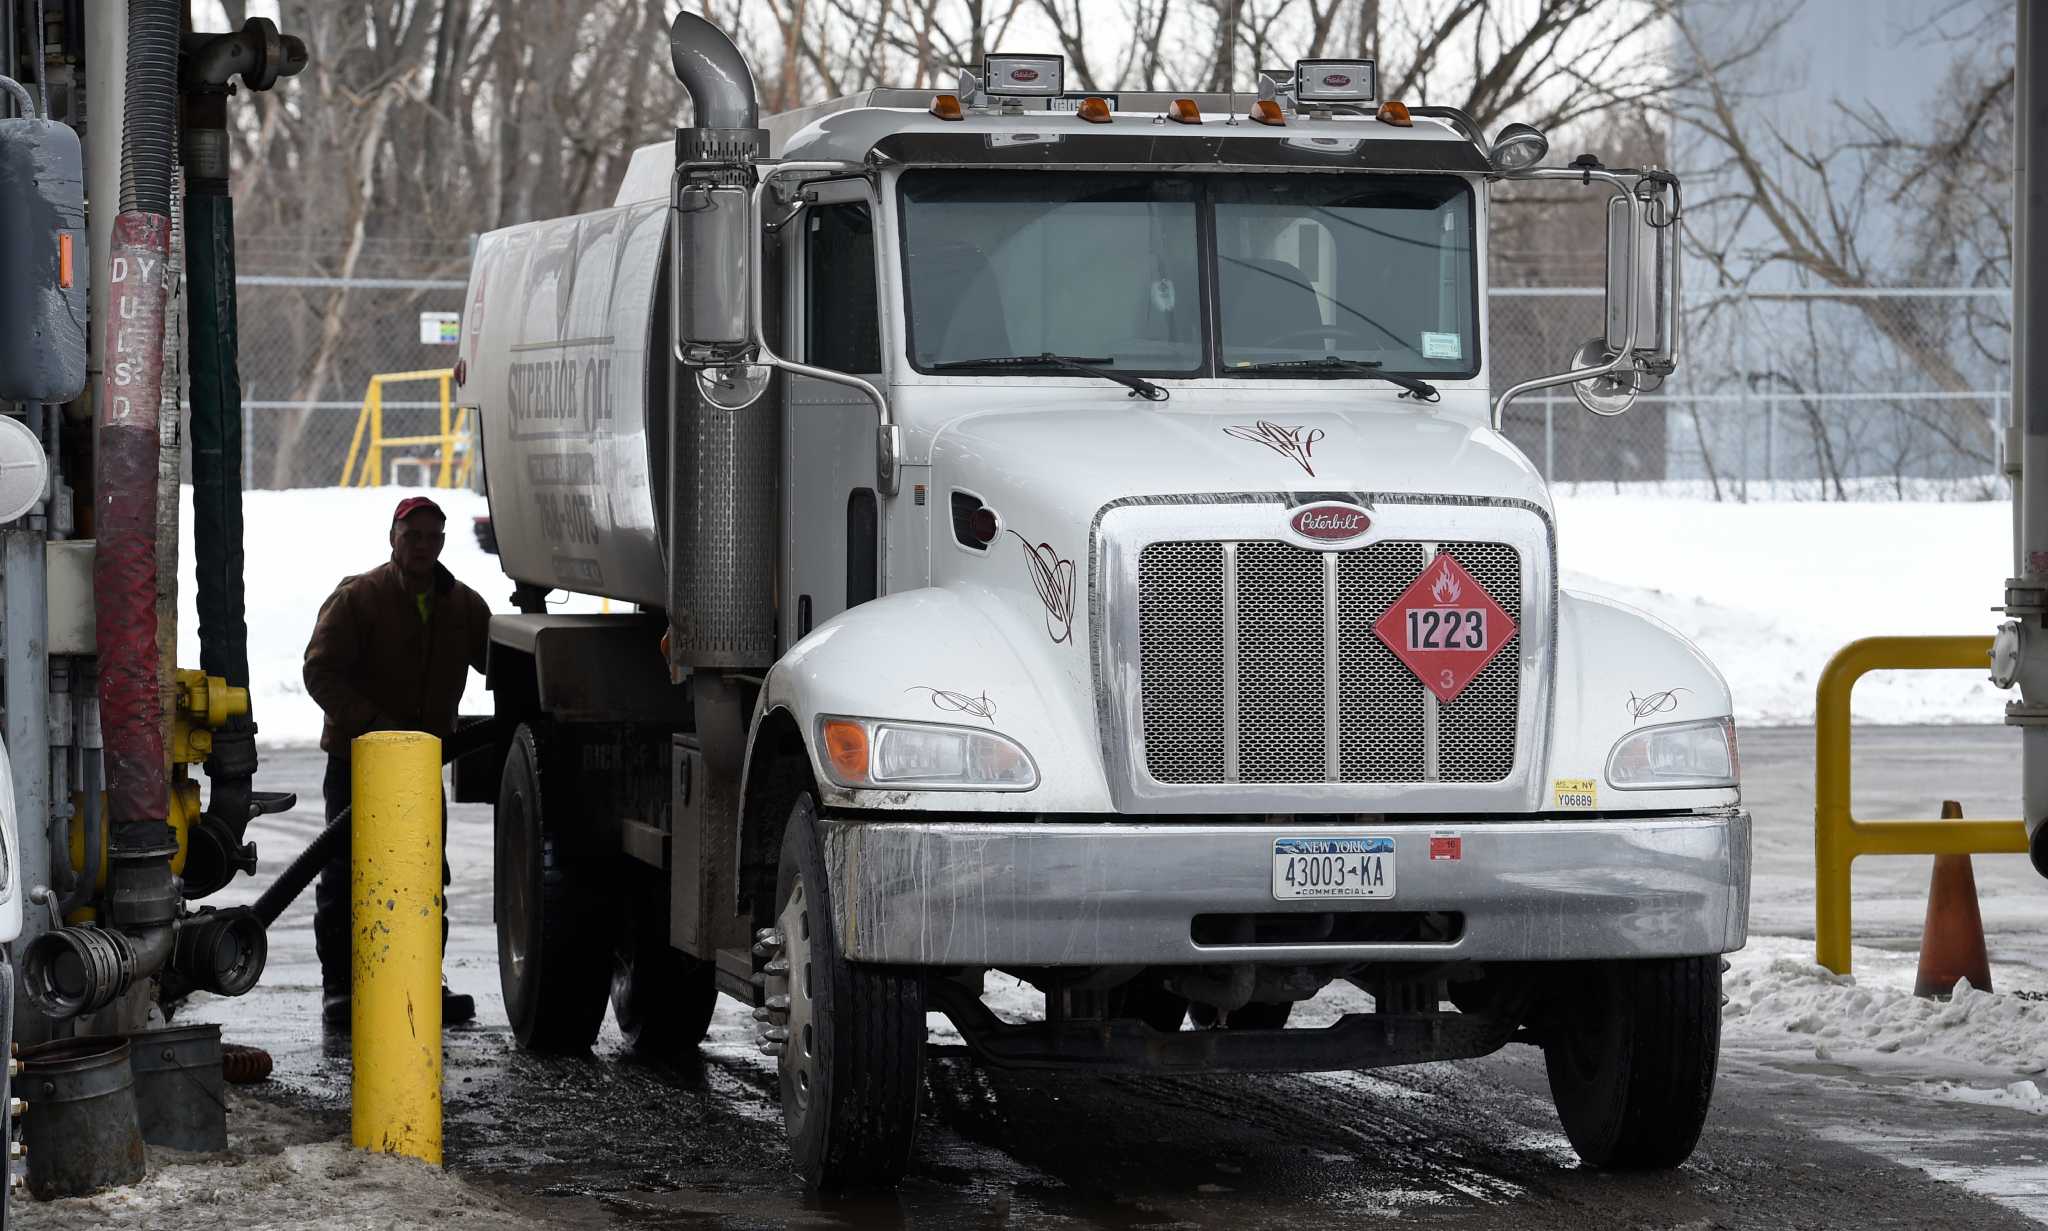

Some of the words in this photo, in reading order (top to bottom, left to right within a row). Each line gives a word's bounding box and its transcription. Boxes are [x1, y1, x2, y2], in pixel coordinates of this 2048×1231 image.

[508, 361, 577, 441] SUPERIOR
[584, 358, 612, 443] OIL
[1300, 511, 1365, 531] Peterbilt
[1408, 610, 1484, 649] 1223
[1440, 668, 1455, 689] 3
[1303, 840, 1331, 853] NEW
[1334, 840, 1367, 853] YORK
[1285, 856, 1345, 888] 43003
[1361, 855, 1384, 887] KA
[1301, 887, 1367, 896] COMMERCIAL
